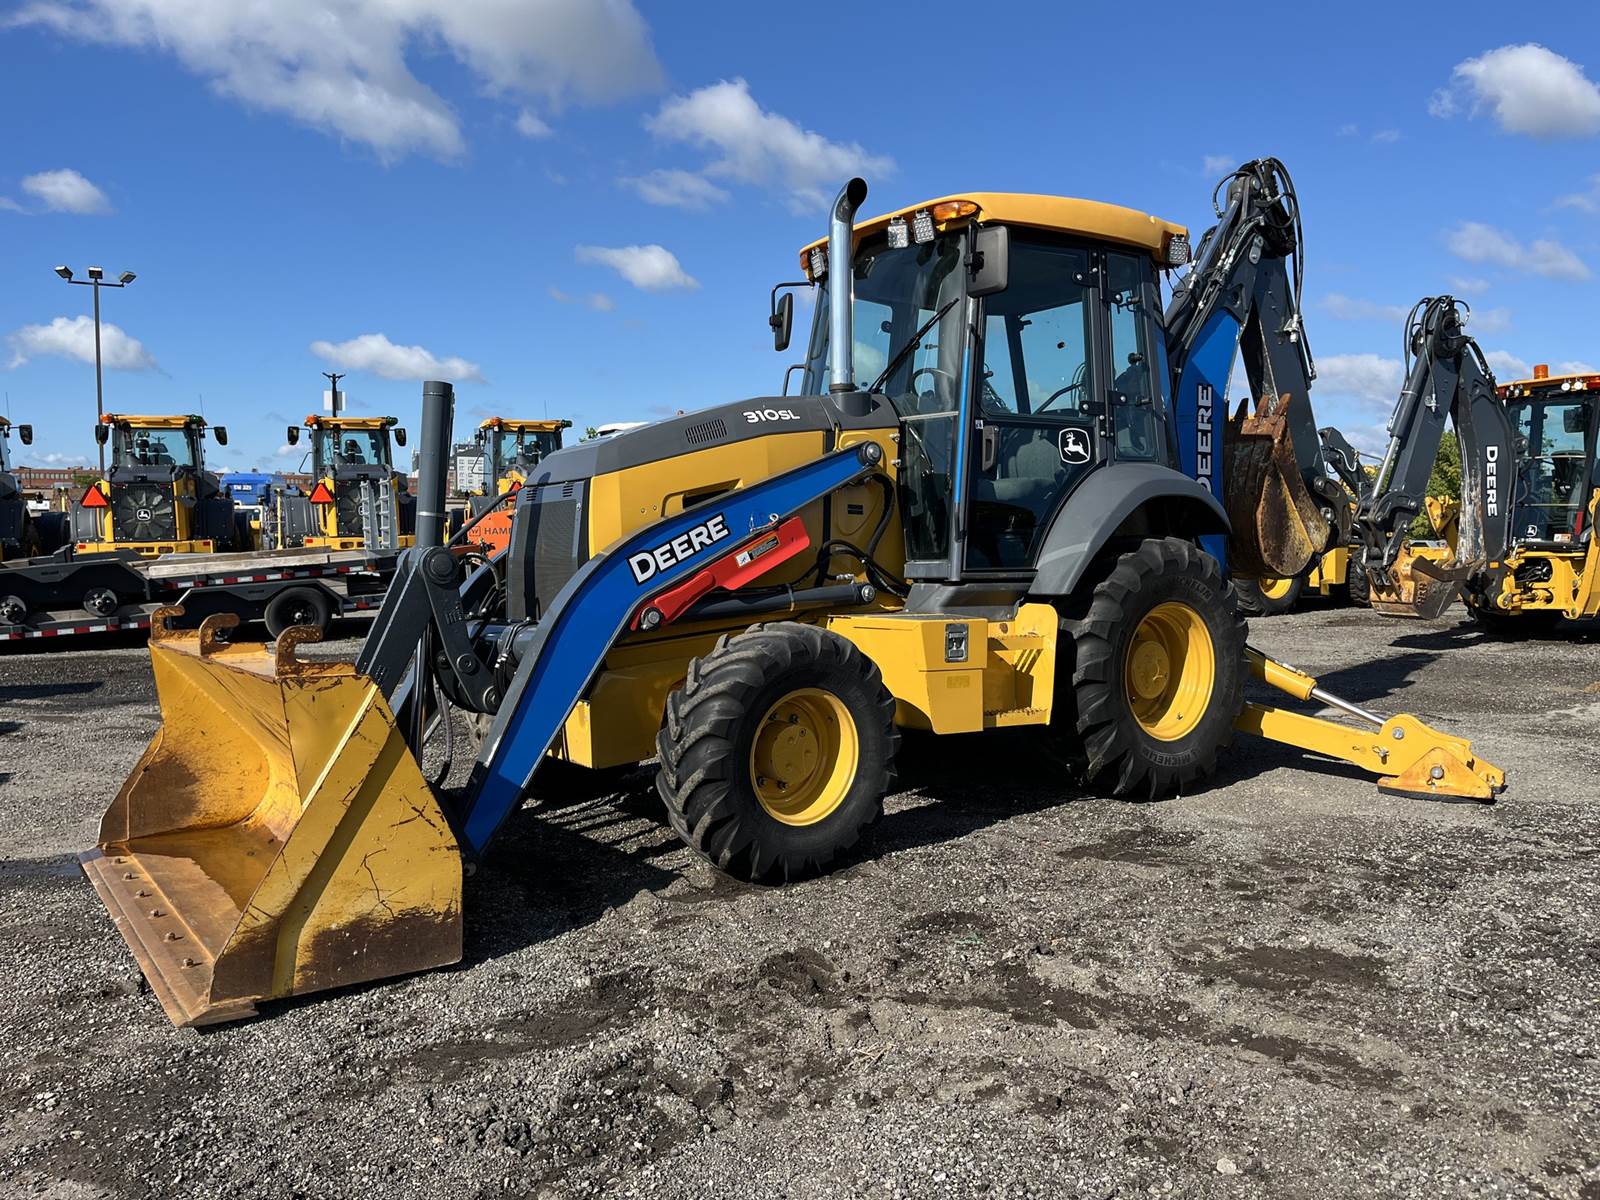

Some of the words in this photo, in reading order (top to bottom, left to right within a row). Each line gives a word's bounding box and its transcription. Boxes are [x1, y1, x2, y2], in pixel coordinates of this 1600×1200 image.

[743, 409, 800, 423] 310SL
[1486, 446, 1498, 516] DEERE
[484, 527, 511, 535] HAM
[629, 515, 728, 583] DEERE
